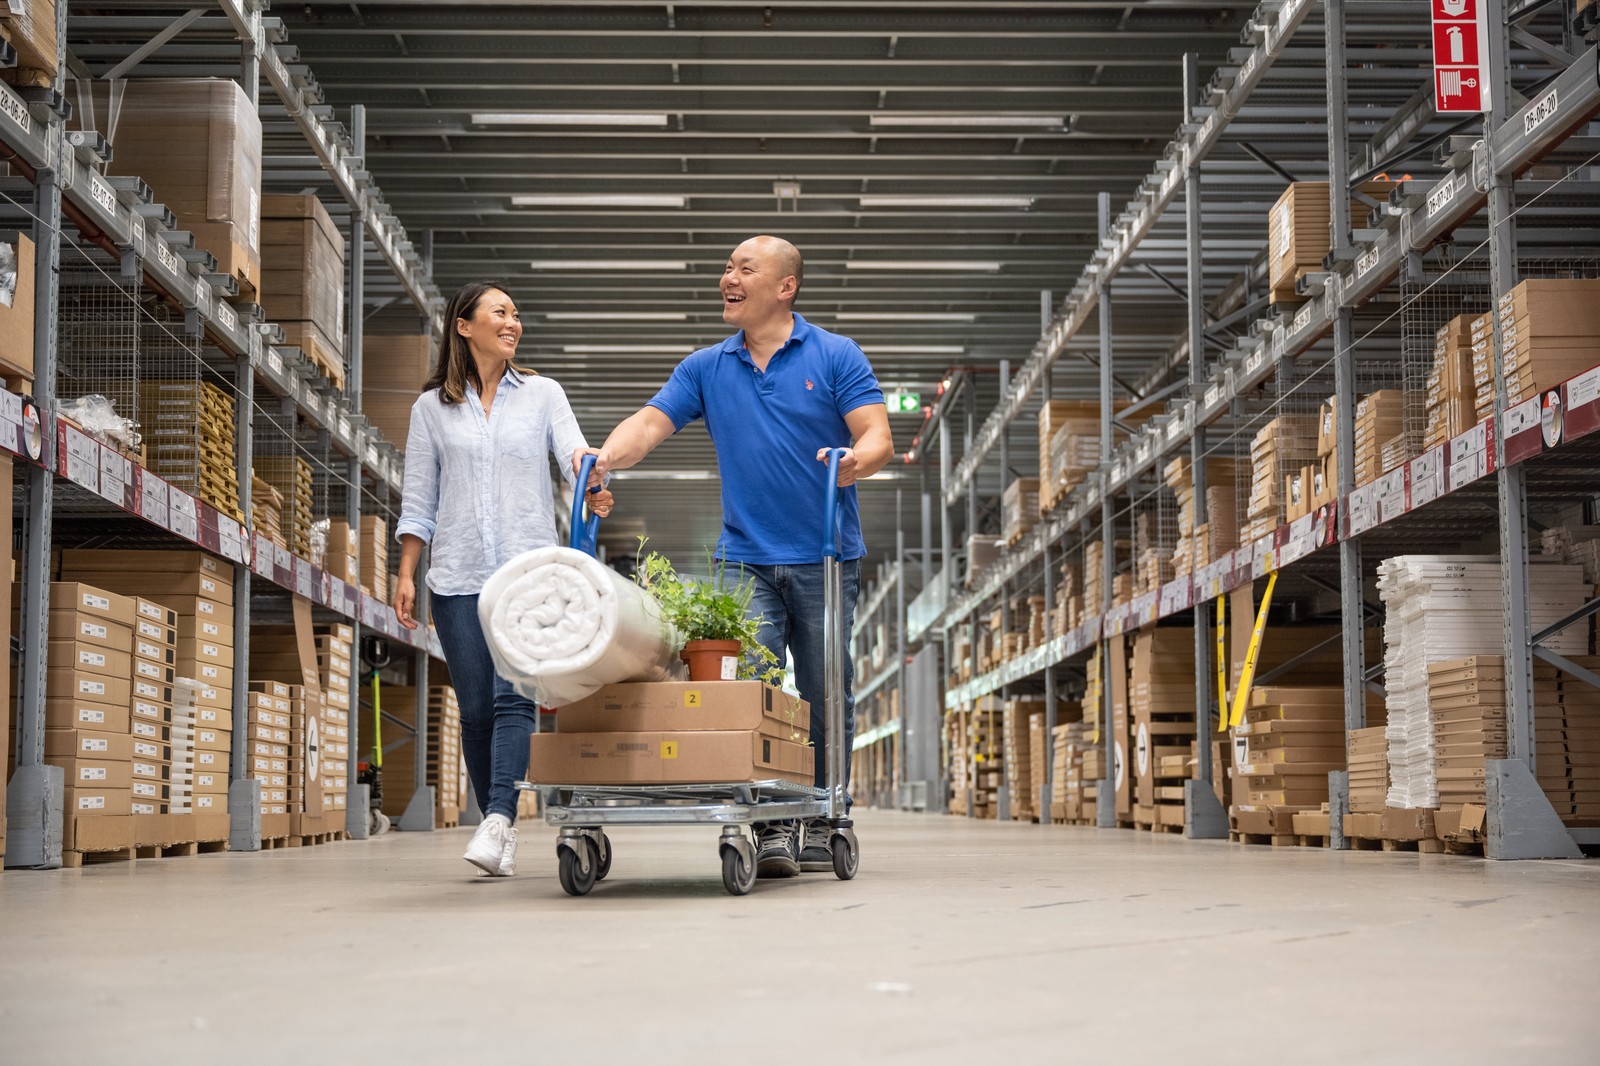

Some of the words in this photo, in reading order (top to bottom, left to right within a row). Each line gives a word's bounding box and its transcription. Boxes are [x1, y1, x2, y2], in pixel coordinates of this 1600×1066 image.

[0, 90, 29, 130] 28-06-20
[1525, 93, 1557, 132] 26-06-20
[1428, 183, 1454, 216] 26-07-20
[689, 694, 697, 704] 2
[666, 745, 672, 755] 1
